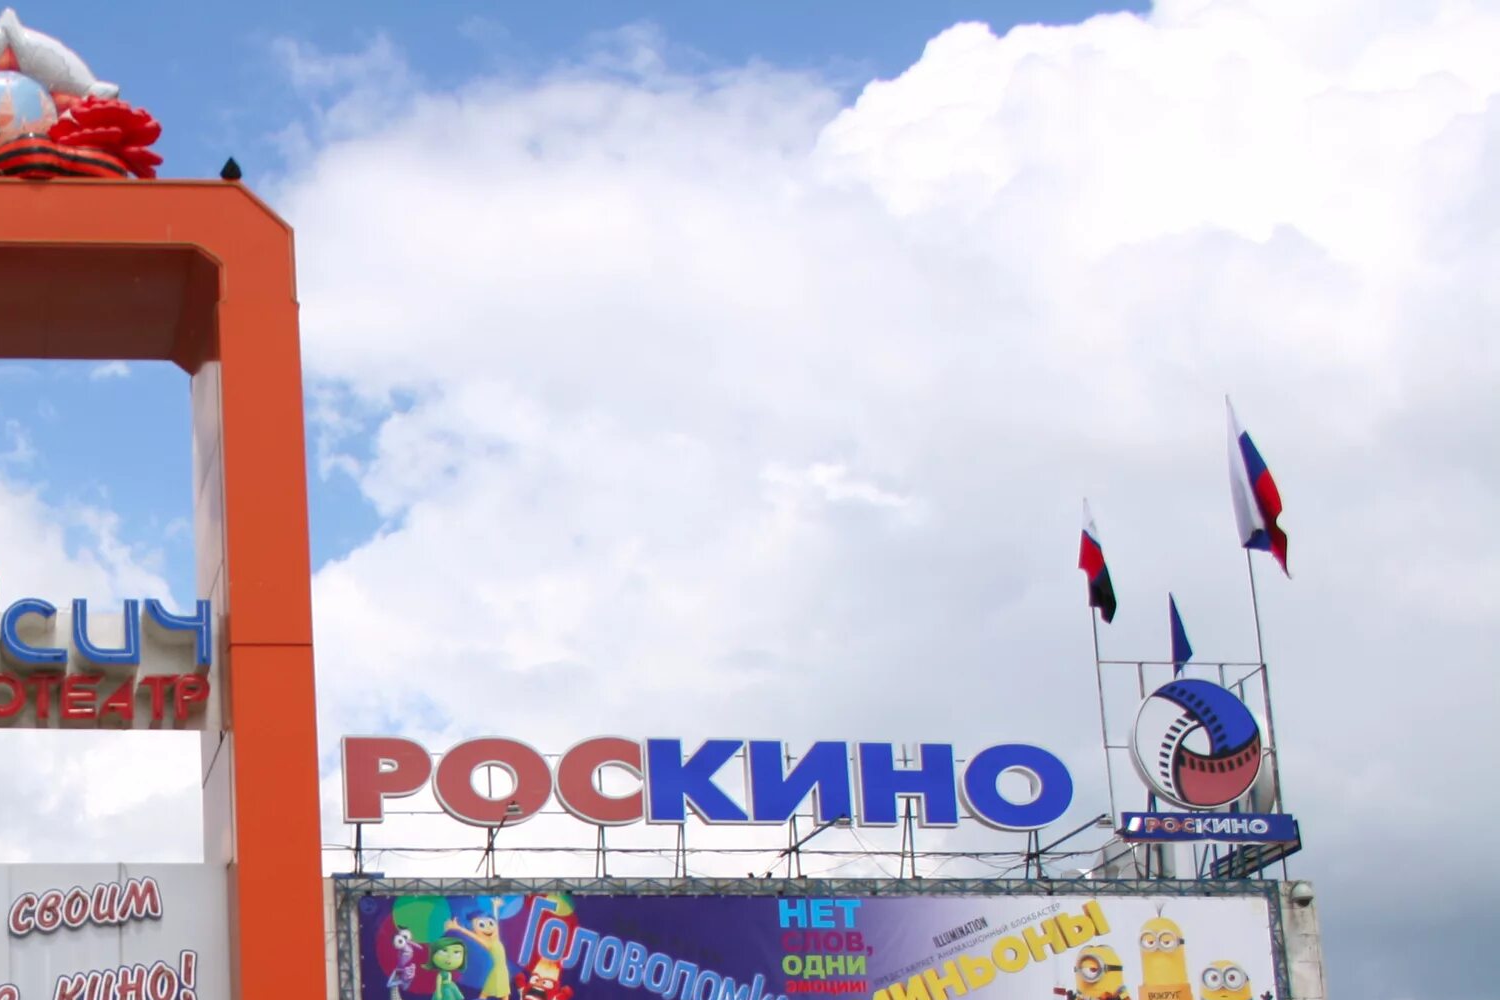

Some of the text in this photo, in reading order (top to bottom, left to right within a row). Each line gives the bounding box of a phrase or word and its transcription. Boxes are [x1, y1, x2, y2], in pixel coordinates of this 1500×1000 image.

[341, 735, 1074, 833] РОСКИНО
[1144, 817, 1269, 834] РОСКИНО
[9, 876, 162, 936] своим
[778, 898, 862, 928] НЕТ
[781, 931, 874, 956] СЛОВ,
[932, 916, 988, 948] ILLUMINATION
[782, 954, 867, 979] ОДНИ
